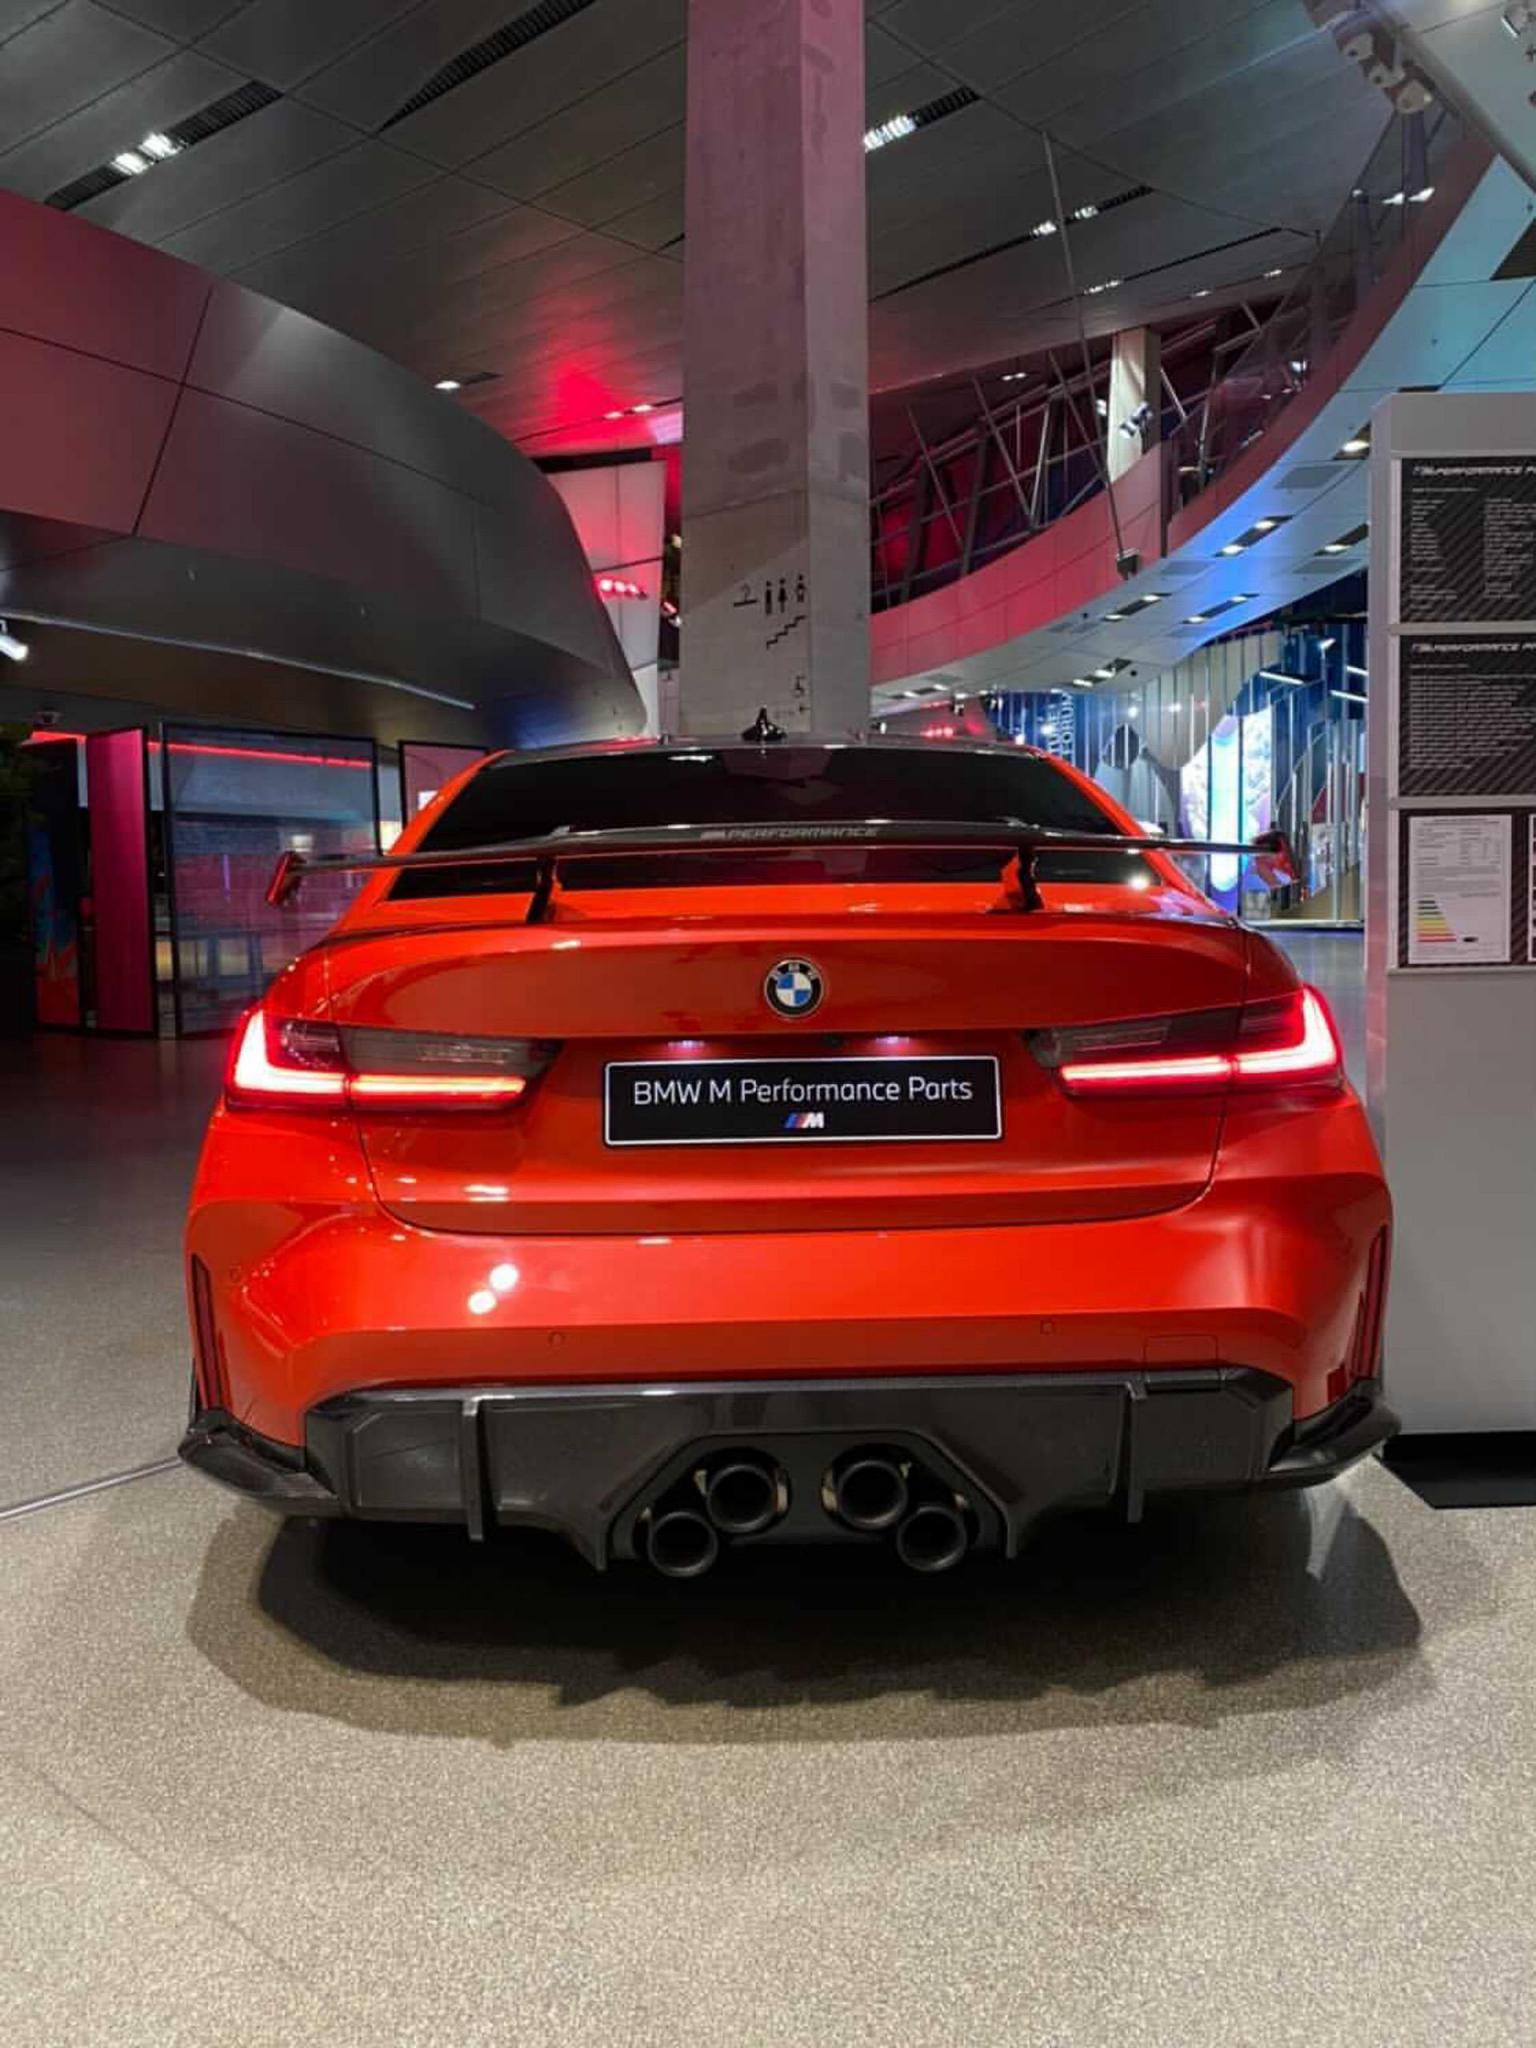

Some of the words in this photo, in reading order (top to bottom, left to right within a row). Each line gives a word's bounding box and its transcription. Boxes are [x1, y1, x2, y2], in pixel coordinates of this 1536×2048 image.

[634, 1079, 701, 1105] BMW
[709, 1079, 731, 1104] M
[740, 1077, 900, 1104] Performance
[908, 1075, 973, 1100] Parts
